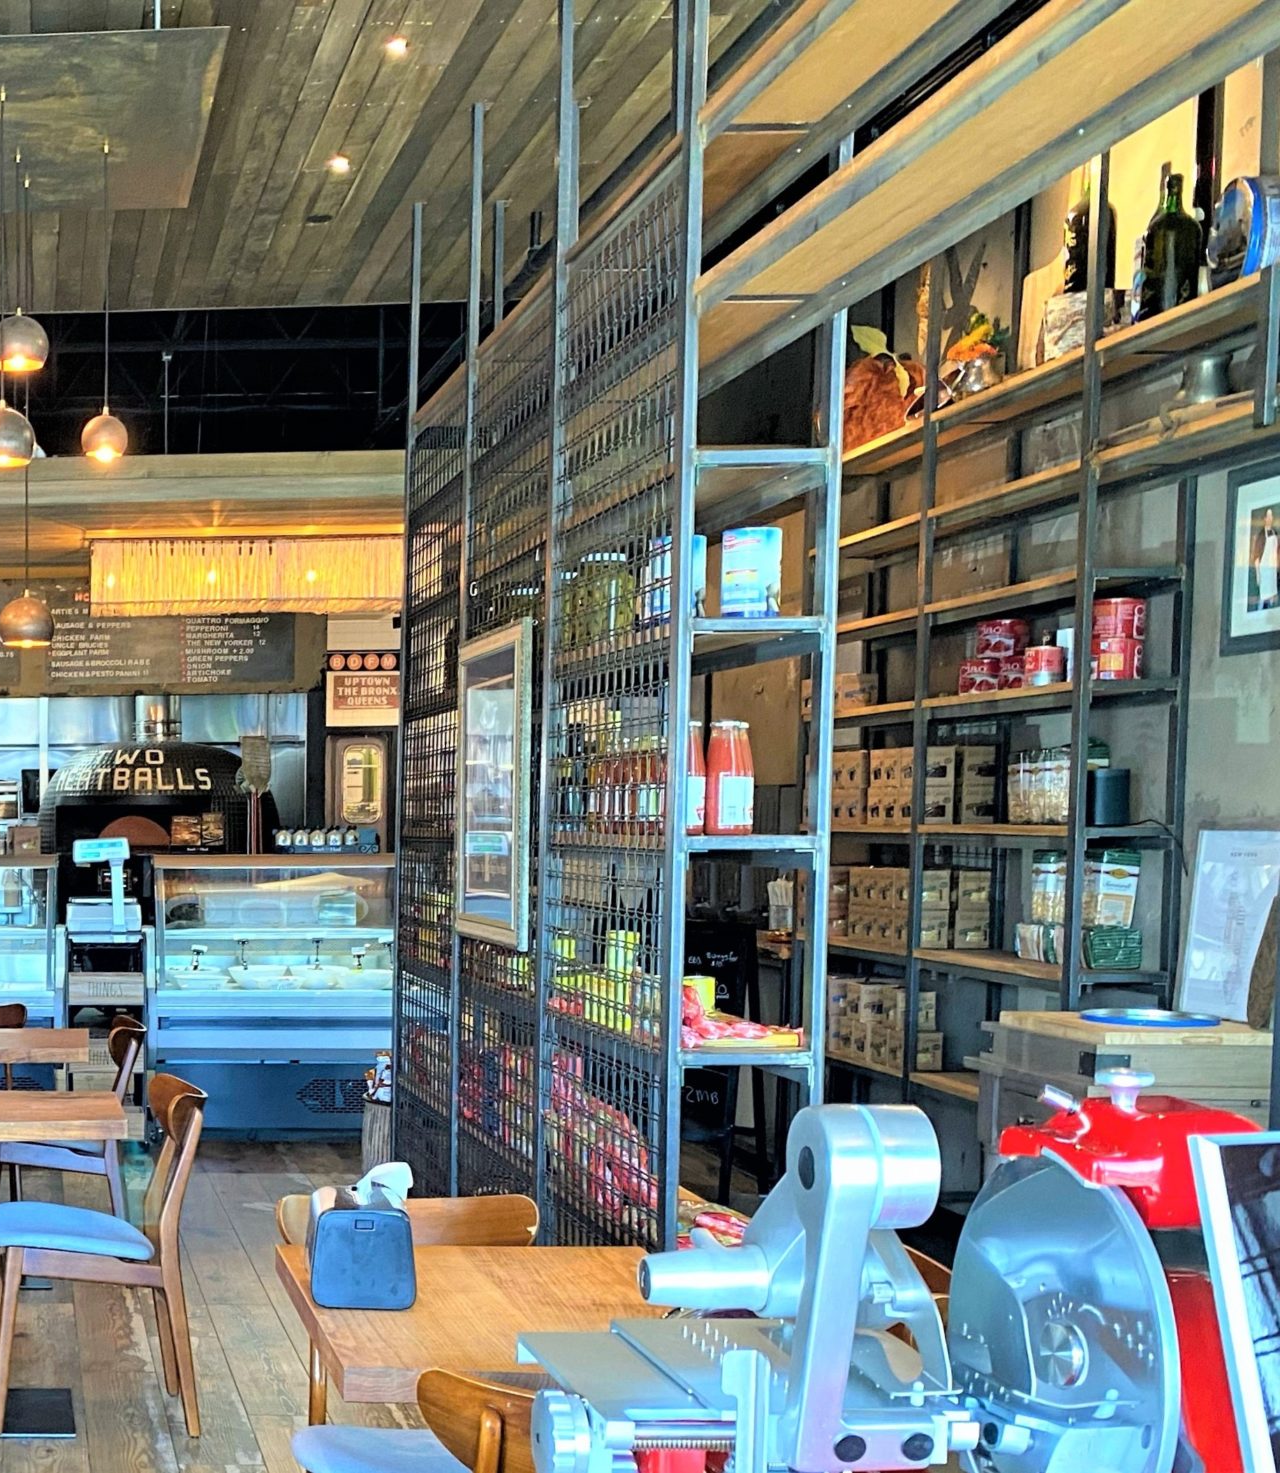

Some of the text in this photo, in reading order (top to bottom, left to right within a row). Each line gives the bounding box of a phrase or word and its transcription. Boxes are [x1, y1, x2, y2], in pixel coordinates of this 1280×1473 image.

[52, 634, 85, 642] CHICKEN
[224, 639, 254, 647] YORKER
[51, 660, 84, 668] SAUSAGE
[333, 657, 340, 667] B
[350, 657, 358, 667] D
[383, 657, 393, 666] M
[344, 677, 391, 686] UPTOWN
[337, 687, 397, 696] THE BRONX
[347, 696, 388, 706] QUEENS
[55, 767, 212, 791] MEATBALLS
